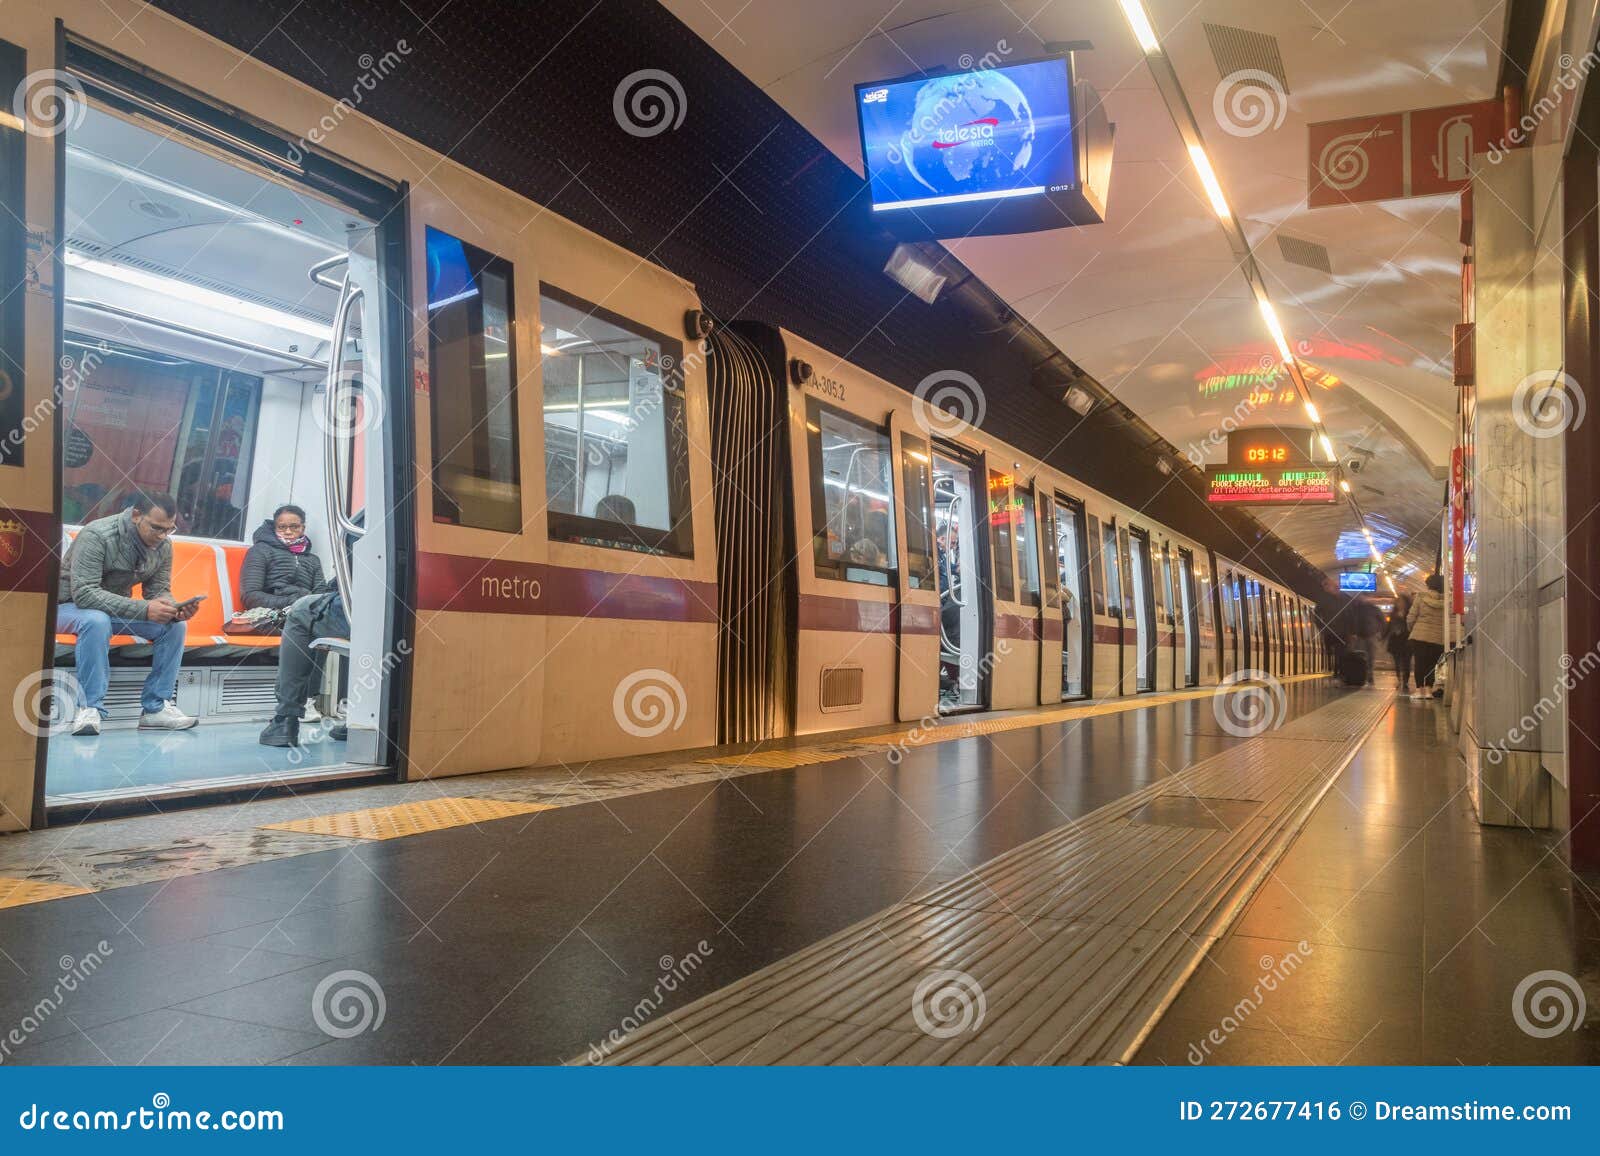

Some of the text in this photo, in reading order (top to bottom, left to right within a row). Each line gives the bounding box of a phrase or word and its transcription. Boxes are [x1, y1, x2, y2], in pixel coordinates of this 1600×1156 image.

[940, 124, 994, 143] telesia
[1247, 448, 1286, 461] 09:12
[1234, 479, 1270, 487] SERVIZIO
[1278, 479, 1293, 487] OUT
[481, 576, 541, 600] metro
